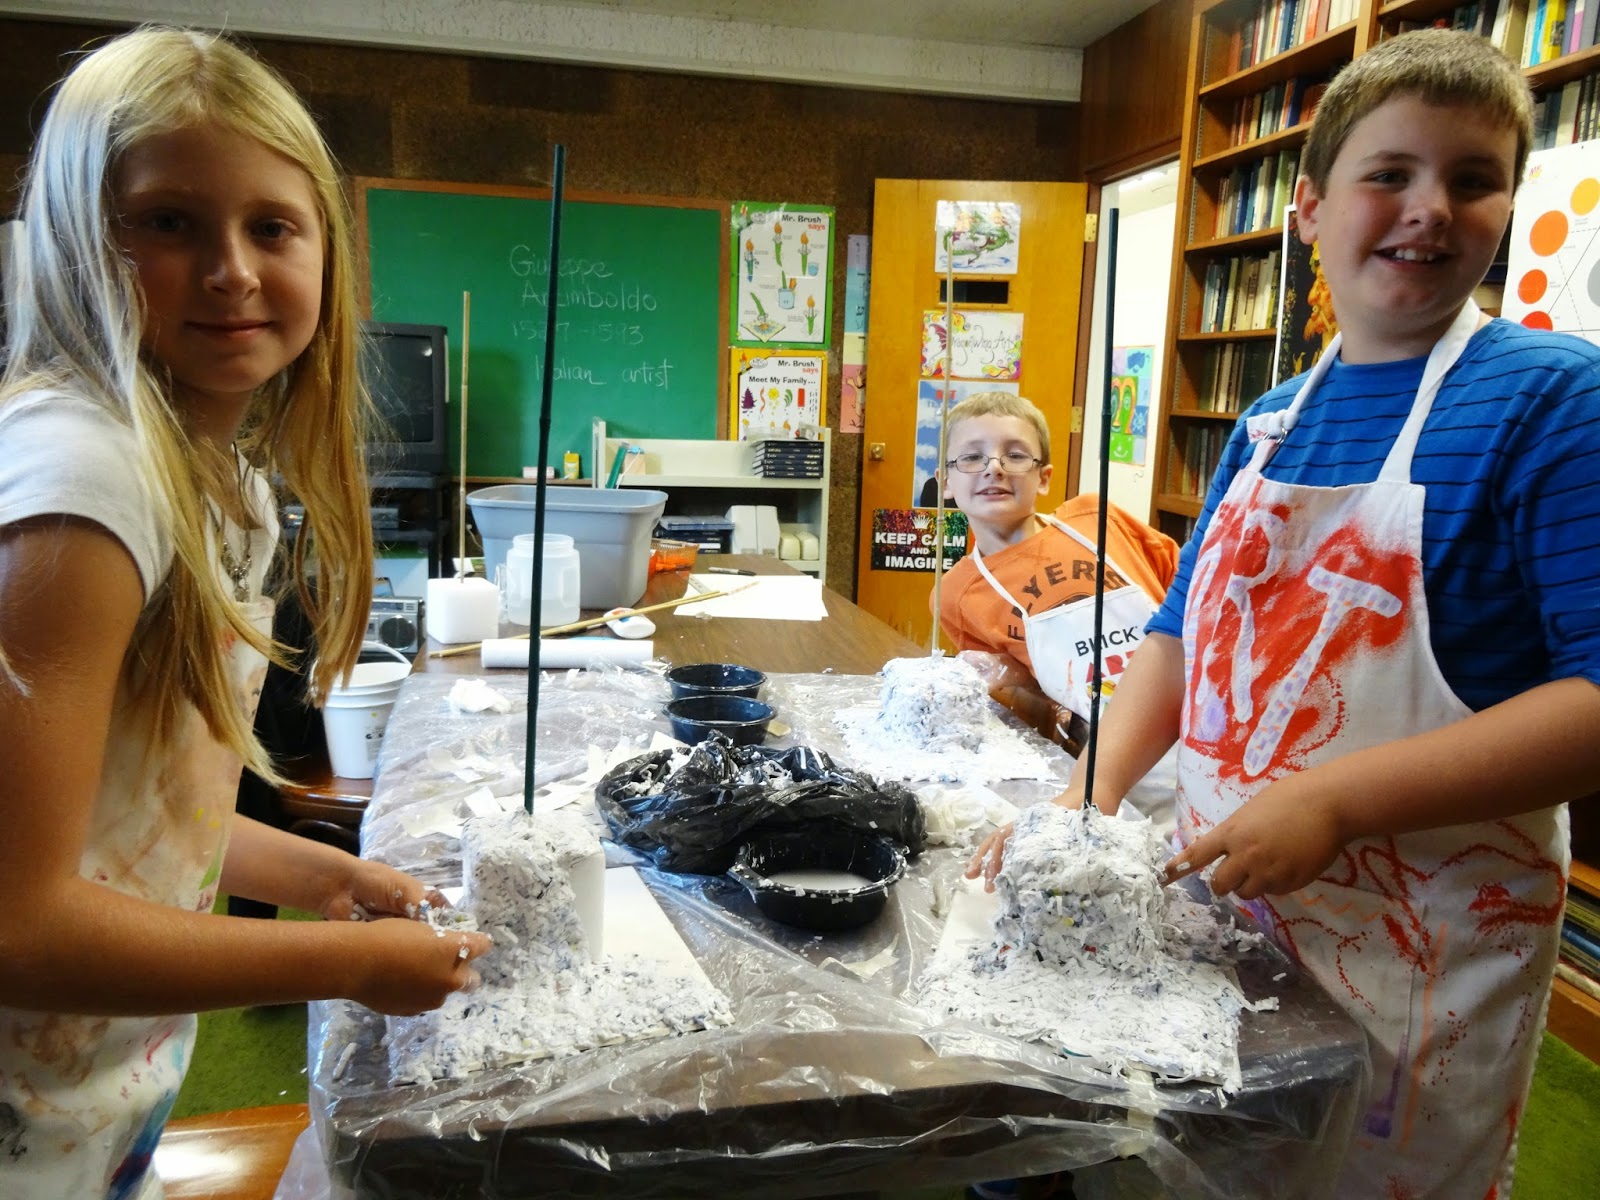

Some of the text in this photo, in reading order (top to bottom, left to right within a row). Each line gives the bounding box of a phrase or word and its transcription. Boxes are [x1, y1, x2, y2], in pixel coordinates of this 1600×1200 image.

[781, 214, 822, 223] Mr. Brush
[509, 244, 614, 285] Giueppe
[535, 355, 673, 390] Ialian artist
[769, 377, 781, 385] My
[874, 531, 918, 545] KEEP
[910, 547, 930, 555] AND
